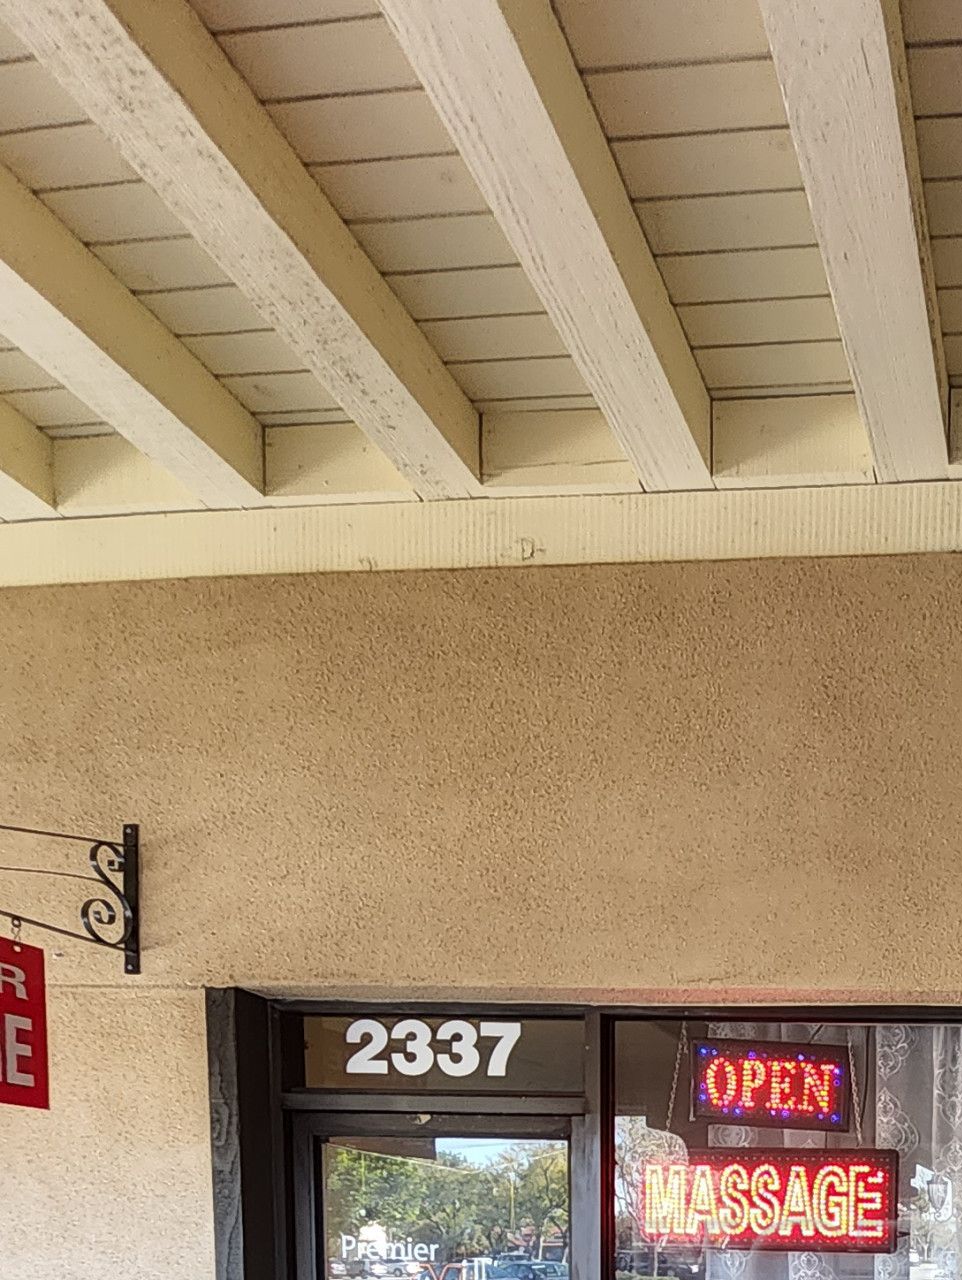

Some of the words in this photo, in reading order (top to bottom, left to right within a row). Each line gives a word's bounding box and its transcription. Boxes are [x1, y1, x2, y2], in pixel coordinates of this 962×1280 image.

[346, 1019, 522, 1077] 2337
[705, 1057, 835, 1113] OPEN
[644, 1163, 884, 1237] MASSAGE
[340, 1234, 440, 1262] Premier
